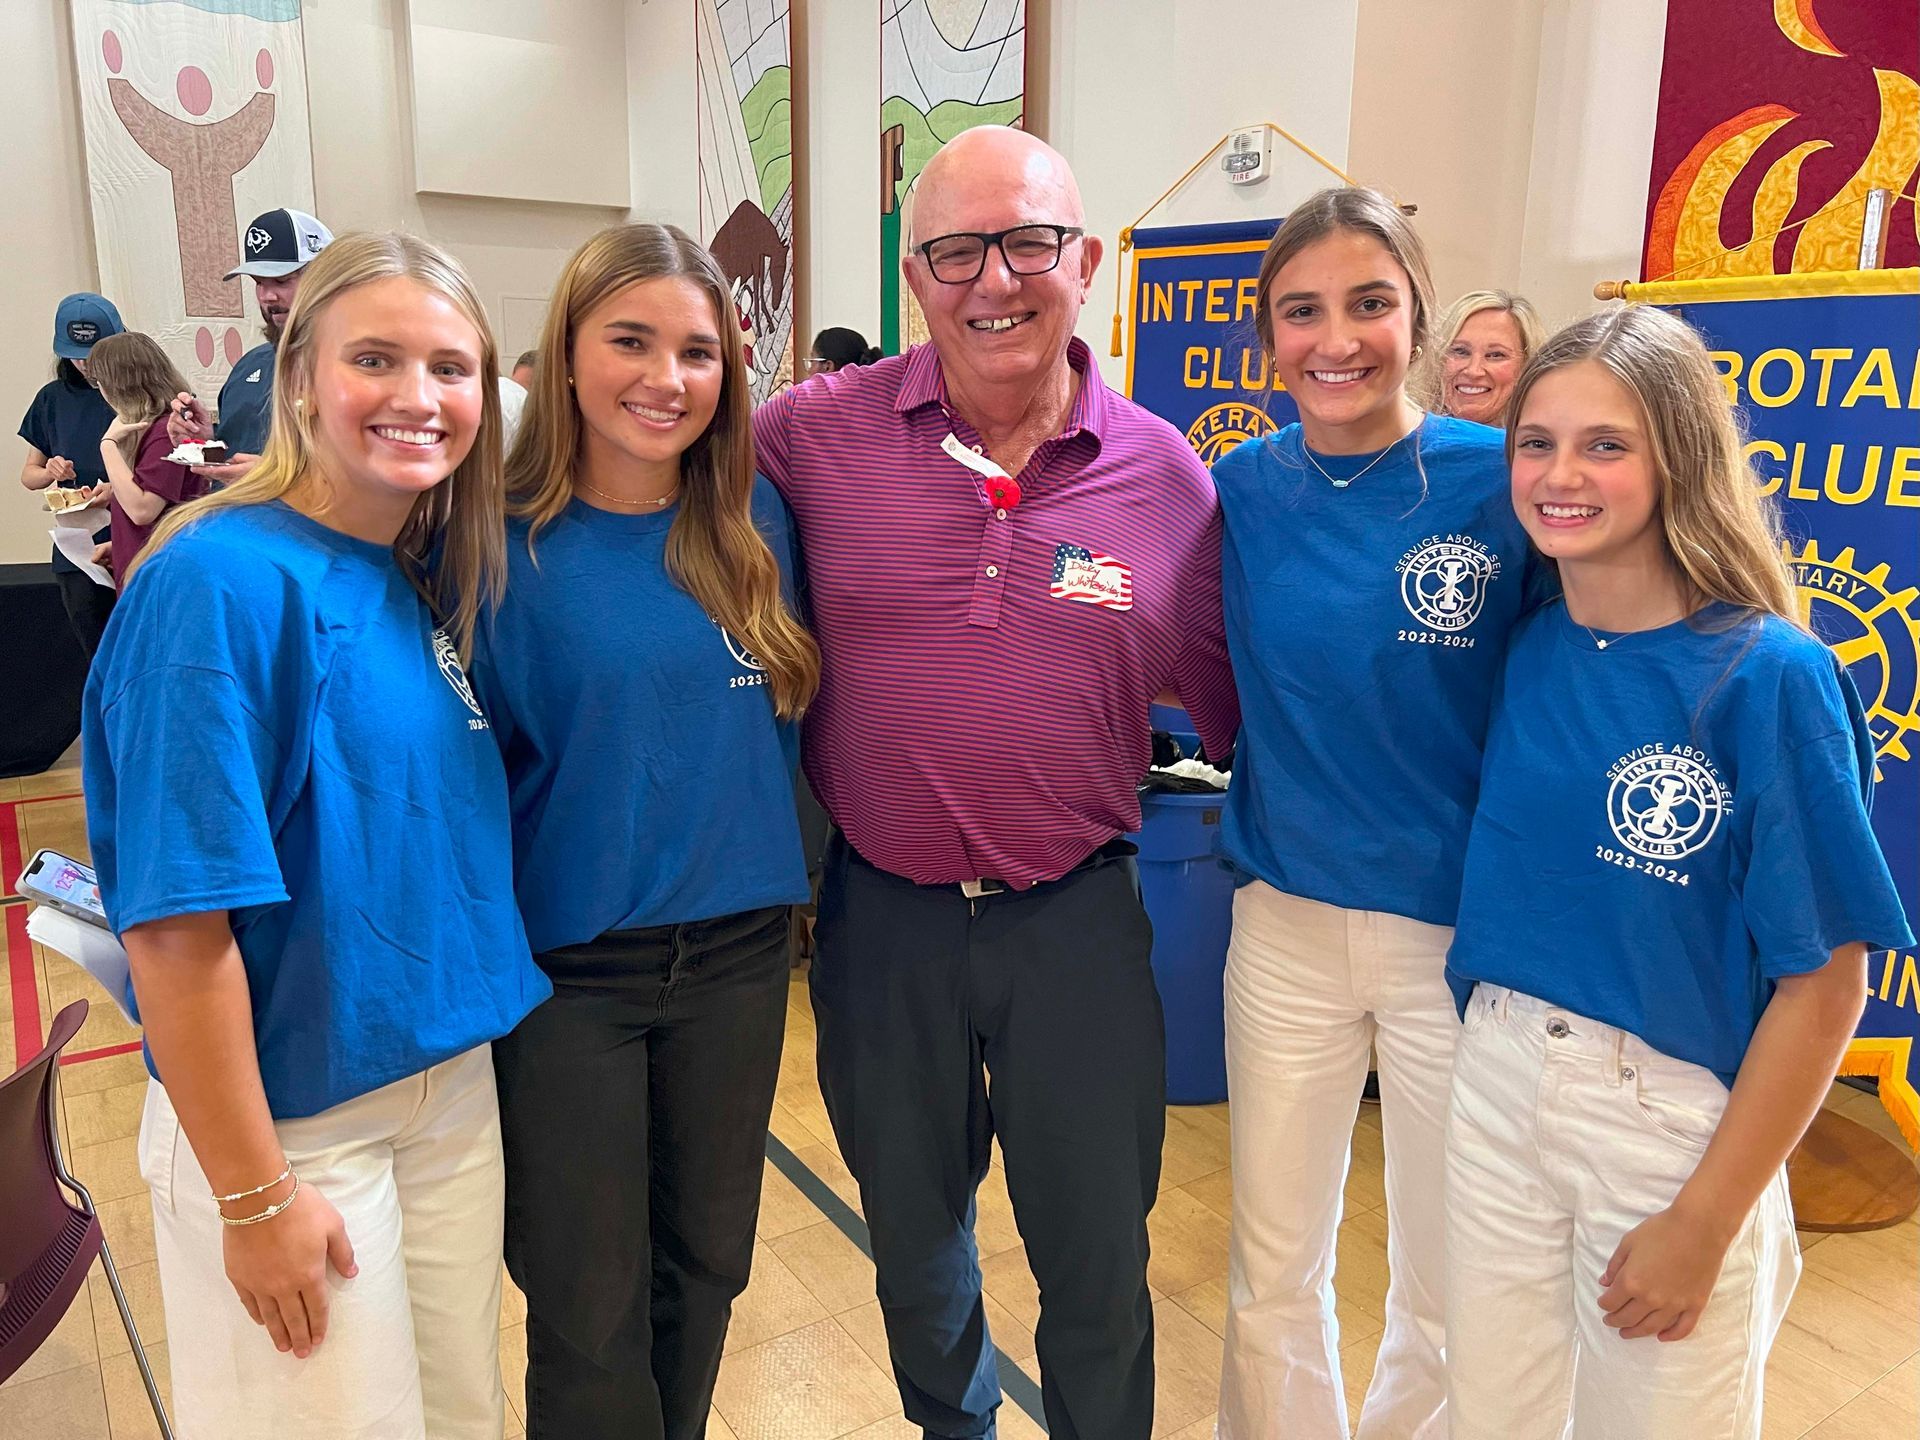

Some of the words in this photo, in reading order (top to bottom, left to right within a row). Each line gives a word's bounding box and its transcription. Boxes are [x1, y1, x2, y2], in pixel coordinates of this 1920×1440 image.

[1232, 172, 1250, 182] FIRE
[1141, 277, 1259, 323] INTER
[1706, 348, 1920, 409] ROTA
[1394, 534, 1441, 574] SERVICE
[1446, 533, 1489, 554] ABOVE
[1413, 547, 1489, 572] INTERACT
[1397, 630, 1475, 648] 2023-2024
[1426, 613, 1466, 627] CLUB
[1606, 742, 1664, 780] SERVICE
[1671, 743, 1719, 777] ABOVE
[1718, 781, 1734, 816] SELF
[1626, 759, 1716, 804] INTERACT
[1626, 833, 1677, 854] CLUB
[1595, 845, 1690, 886] 2023-2024
